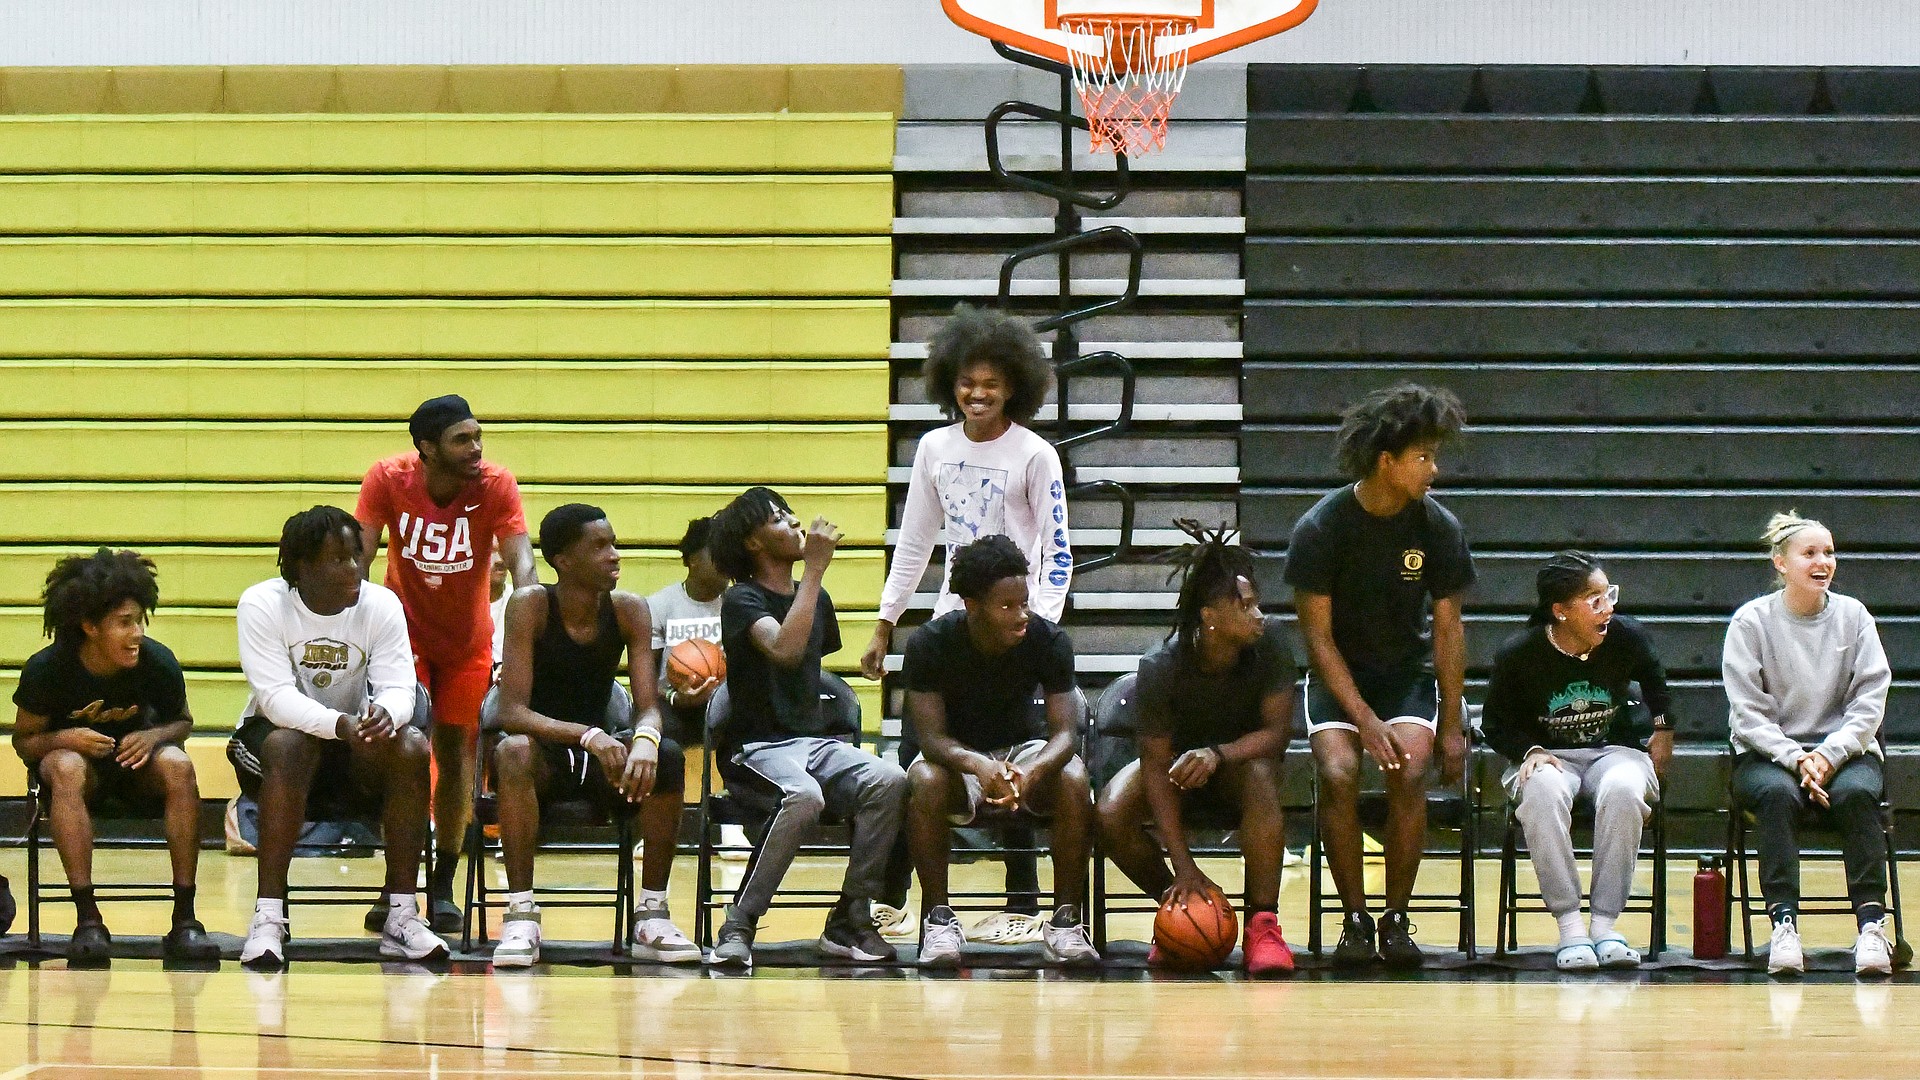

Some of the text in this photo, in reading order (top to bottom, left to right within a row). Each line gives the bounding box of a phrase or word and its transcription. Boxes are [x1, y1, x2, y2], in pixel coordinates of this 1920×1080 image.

[399, 511, 474, 561] USA
[443, 562, 468, 571] CENTER
[669, 624, 699, 639] JUST
[299, 661, 348, 670] FOOTBALL
